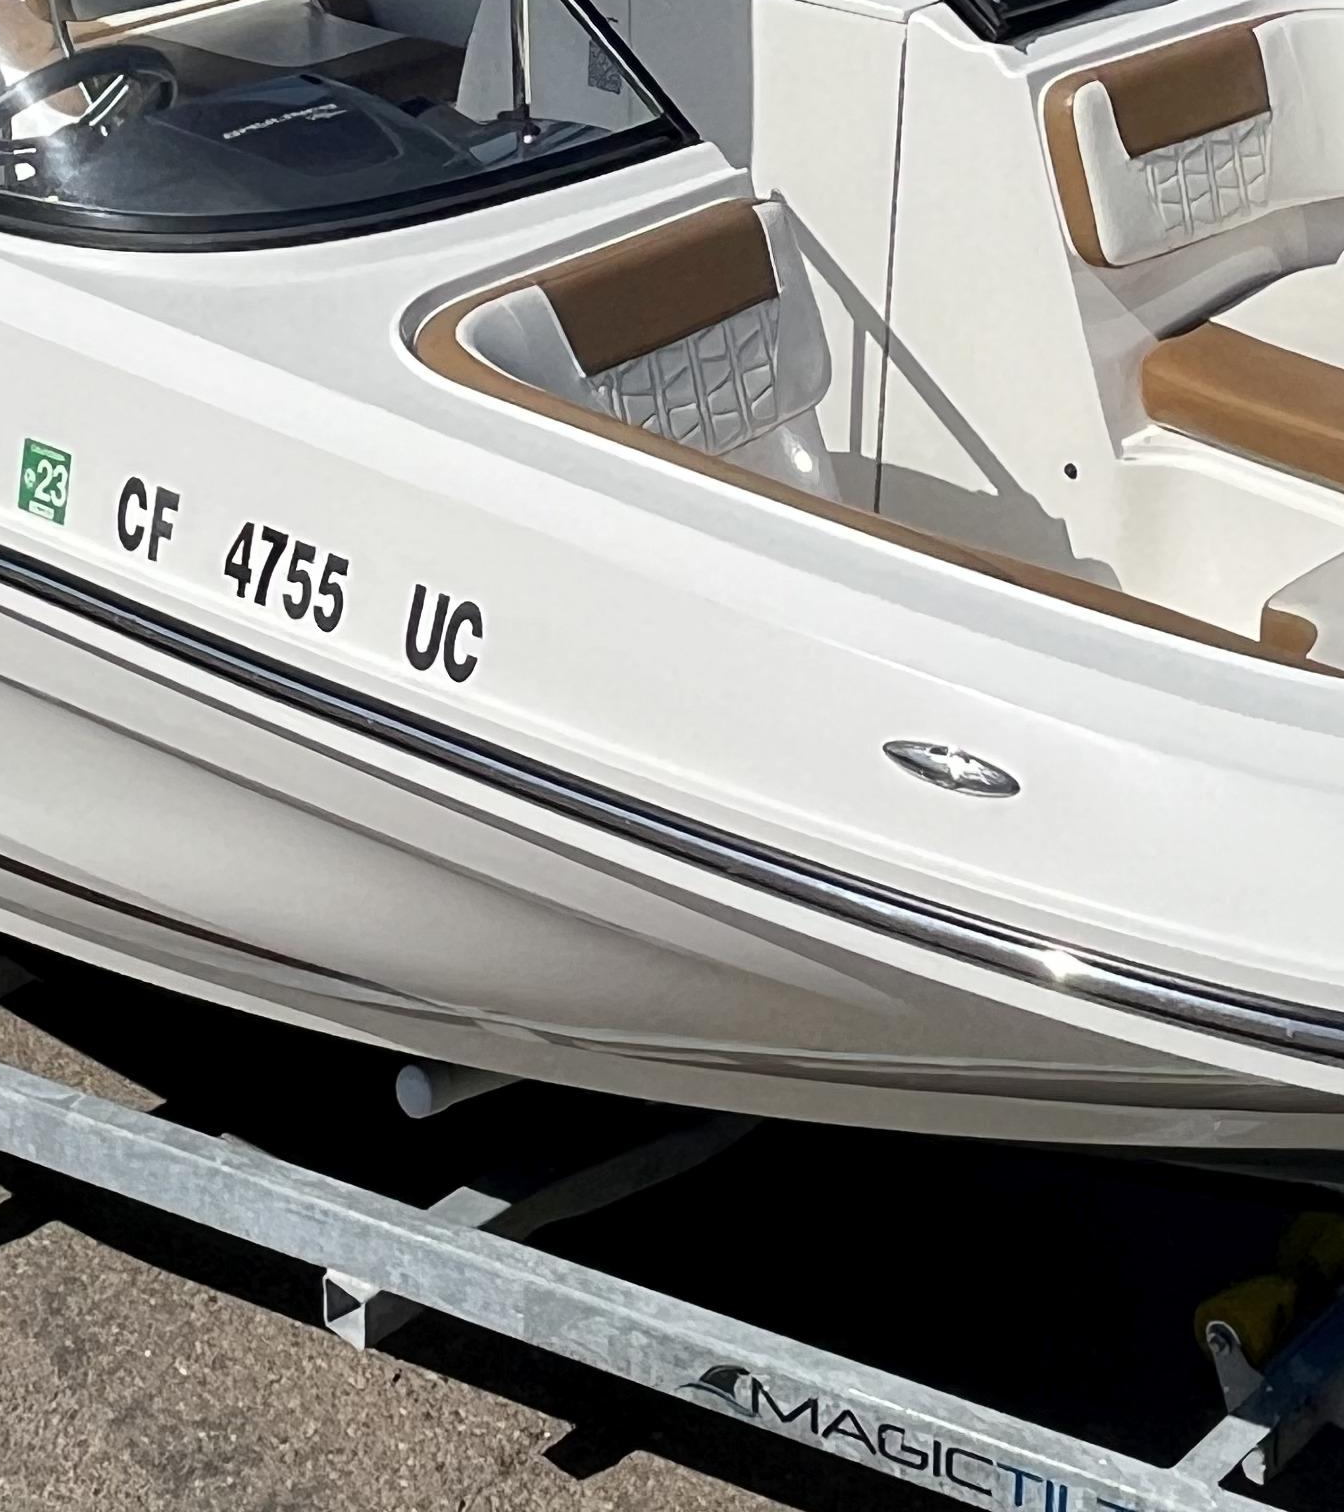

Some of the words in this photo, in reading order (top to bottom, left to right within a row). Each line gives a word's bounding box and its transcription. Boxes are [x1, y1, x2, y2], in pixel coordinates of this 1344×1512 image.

[34, 458, 69, 508] 23
[117, 476, 180, 561] CF
[224, 522, 349, 633] 4755
[405, 584, 484, 683] UC
